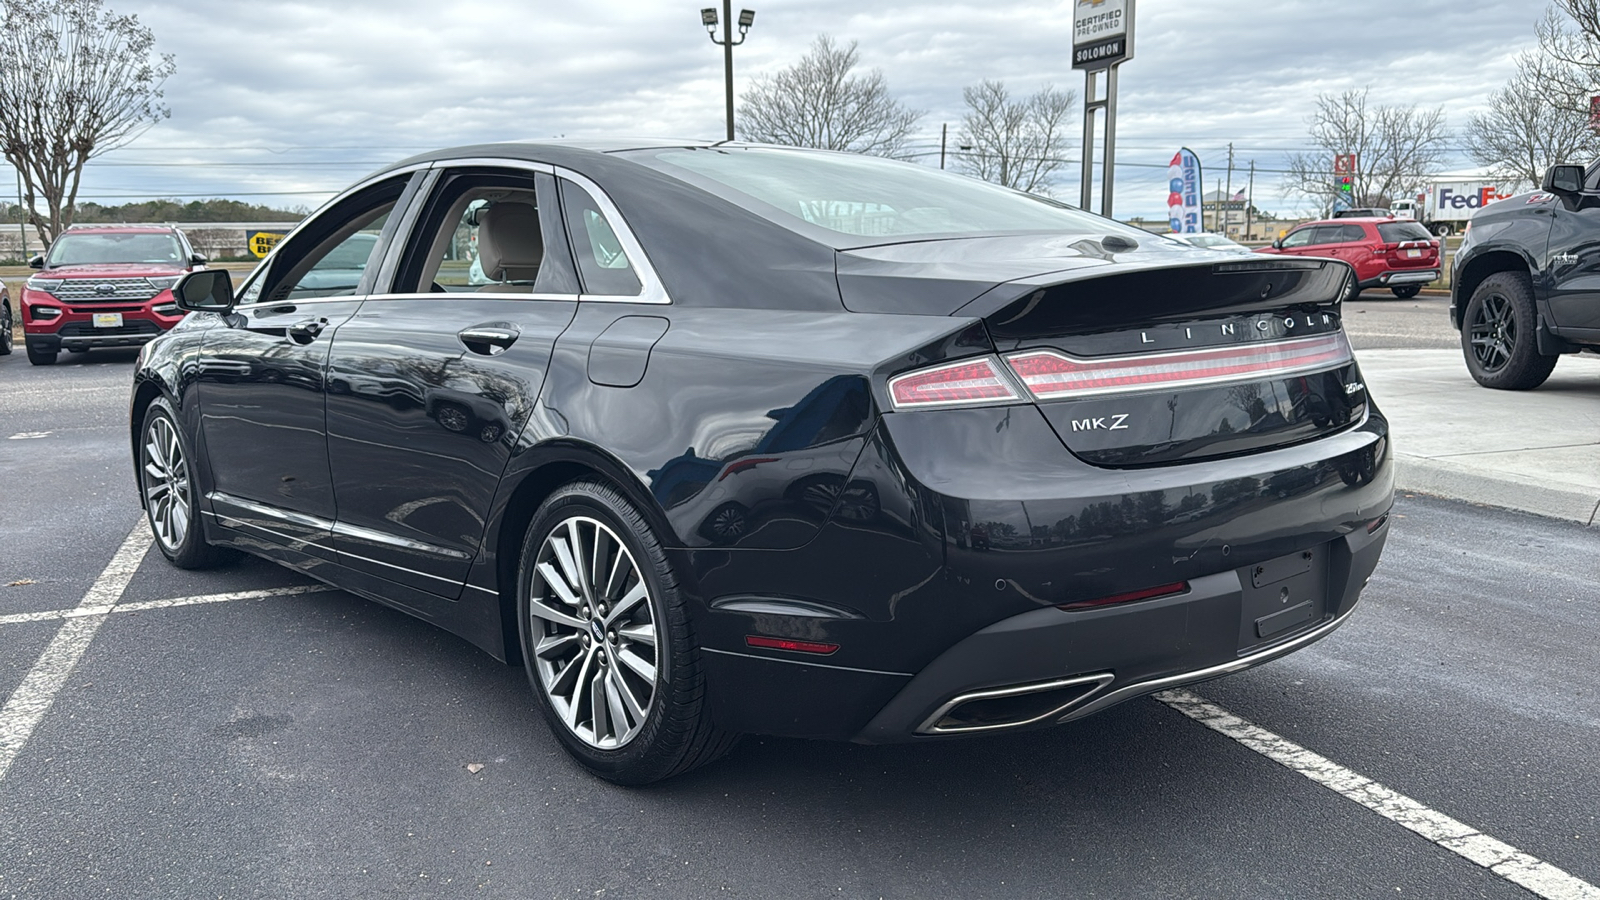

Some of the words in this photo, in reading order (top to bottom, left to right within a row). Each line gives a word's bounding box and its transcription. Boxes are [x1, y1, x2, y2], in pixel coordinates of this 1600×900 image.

[1076, 9, 1122, 28] CERTIFIED
[1077, 19, 1119, 36] PRE-OWNED
[1076, 42, 1119, 62] SOLOMON
[1141, 314, 1330, 343] LINCOLN
[1071, 413, 1130, 432] MKZ
